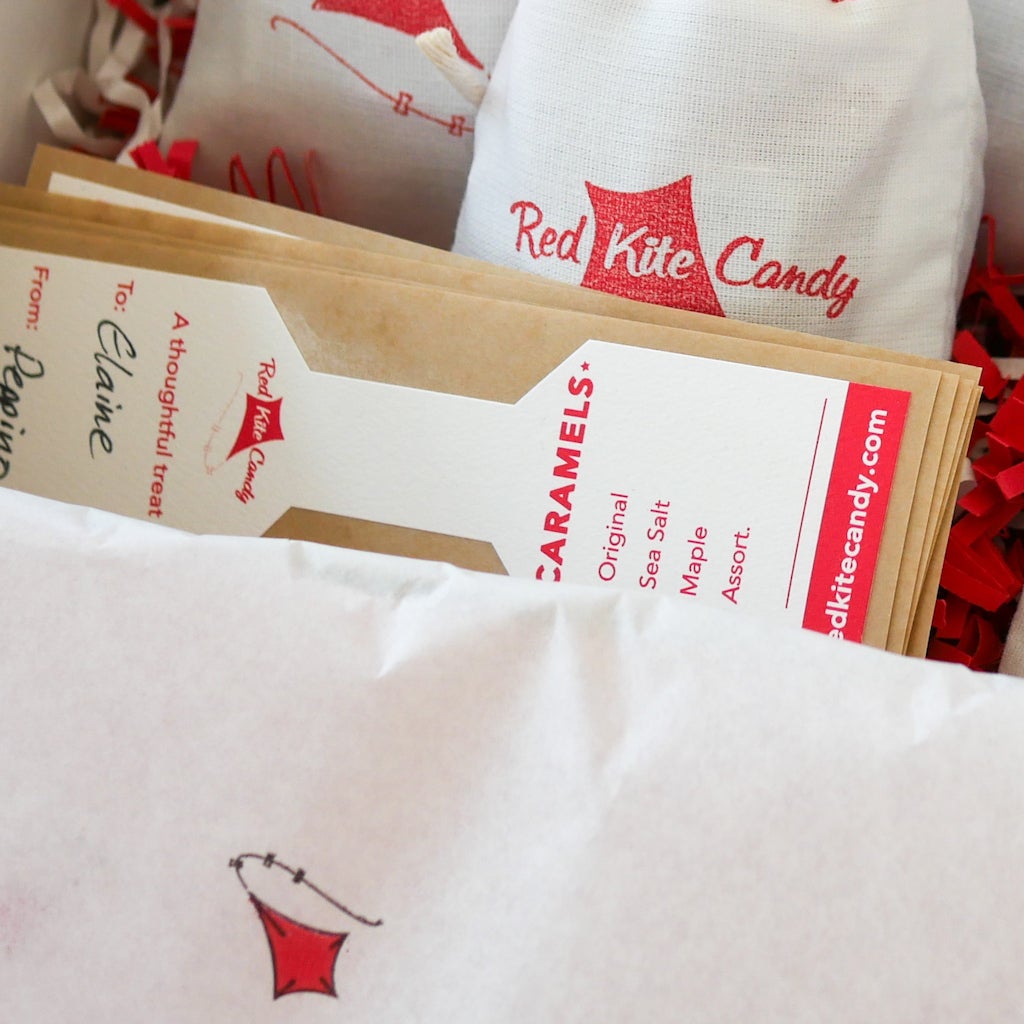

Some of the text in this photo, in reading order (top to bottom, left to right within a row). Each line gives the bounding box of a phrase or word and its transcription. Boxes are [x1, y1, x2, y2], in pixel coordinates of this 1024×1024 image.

[26, 265, 49, 331] From:
[114, 280, 134, 313] To:
[510, 201, 860, 318] Red Kite Candy
[89, 319, 137, 459] Elaine
[148, 311, 190, 518] A thoughtful treat
[234, 357, 276, 504] Red Kite Candy
[598, 492, 629, 582] Original
[639, 499, 671, 589] Sea Salt
[679, 526, 708, 596] Maple
[721, 527, 751, 604] Assort.
[825, 408, 888, 641] edkitecandy.com
